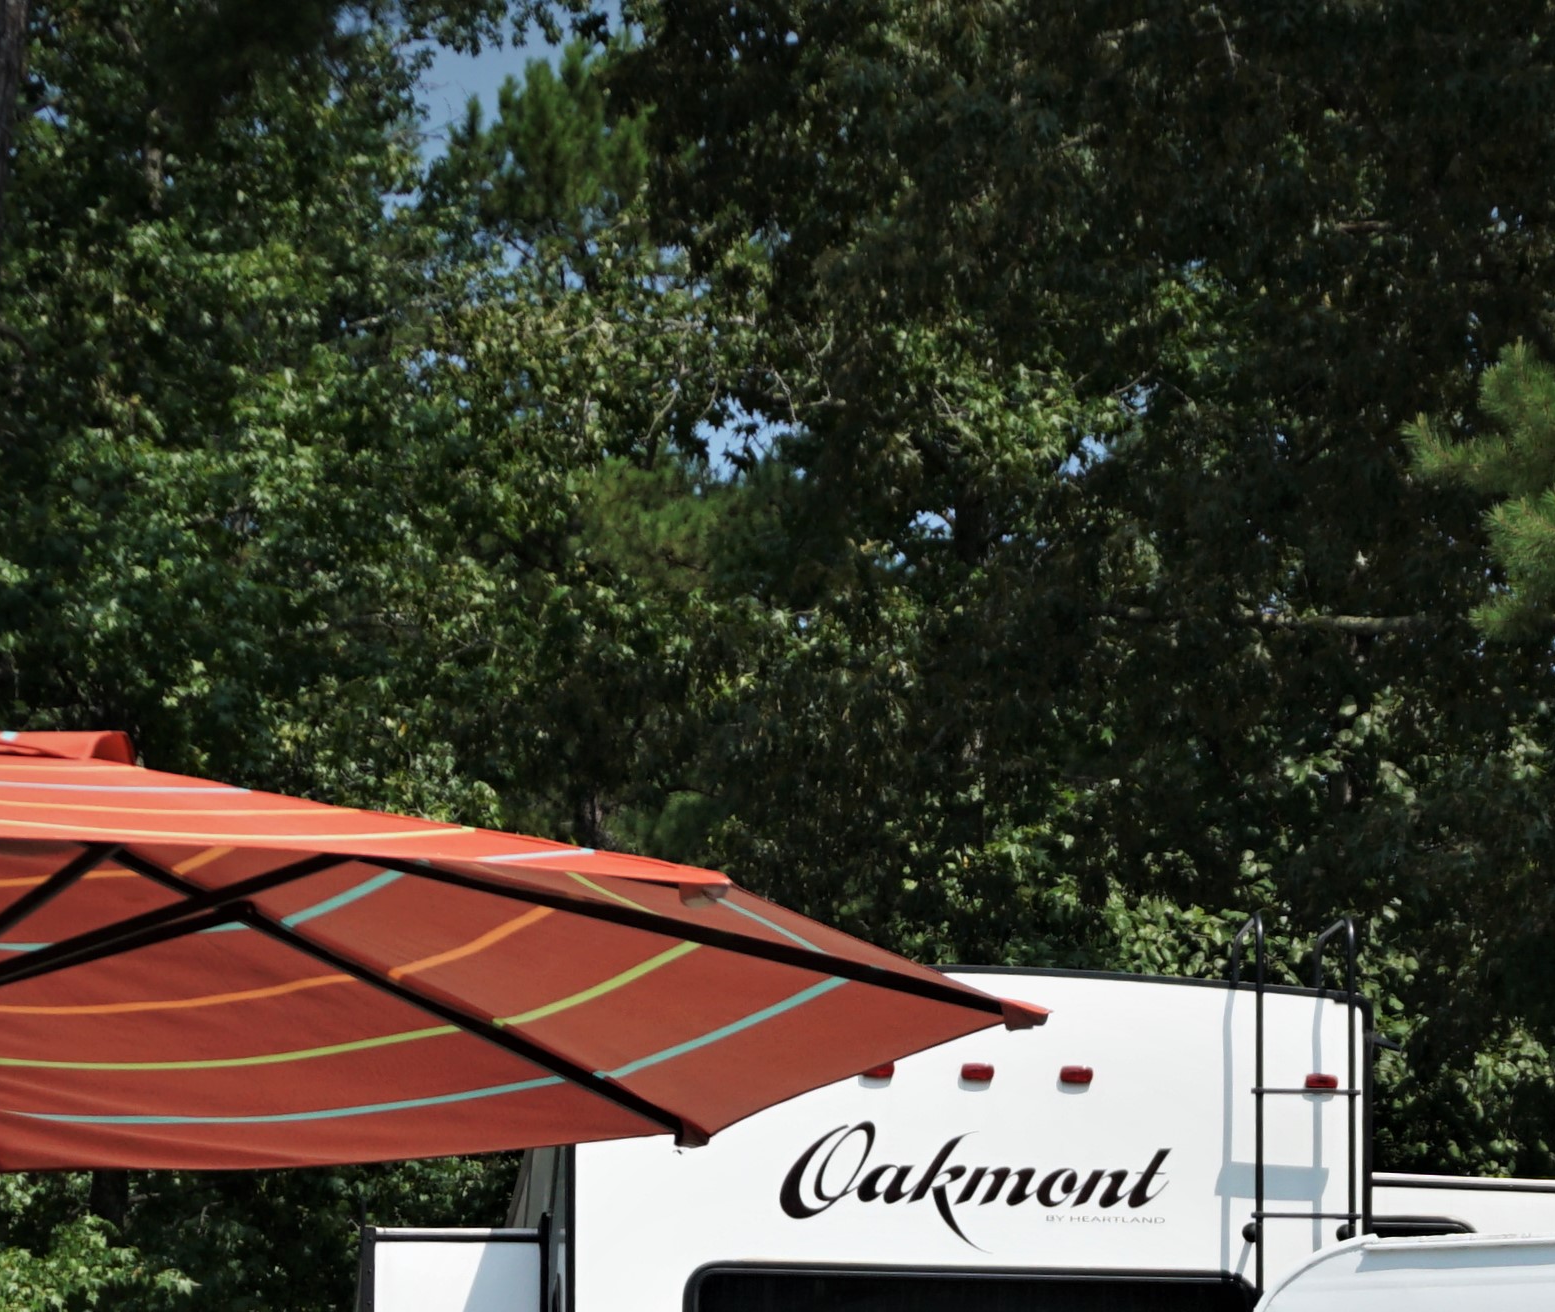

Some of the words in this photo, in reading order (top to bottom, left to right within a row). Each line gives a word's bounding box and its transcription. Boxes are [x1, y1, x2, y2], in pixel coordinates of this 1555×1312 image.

[779, 1120, 1172, 1254] Oakmont
[1045, 1214, 1065, 1222] BY
[1069, 1215, 1166, 1224] HEARTLAND
